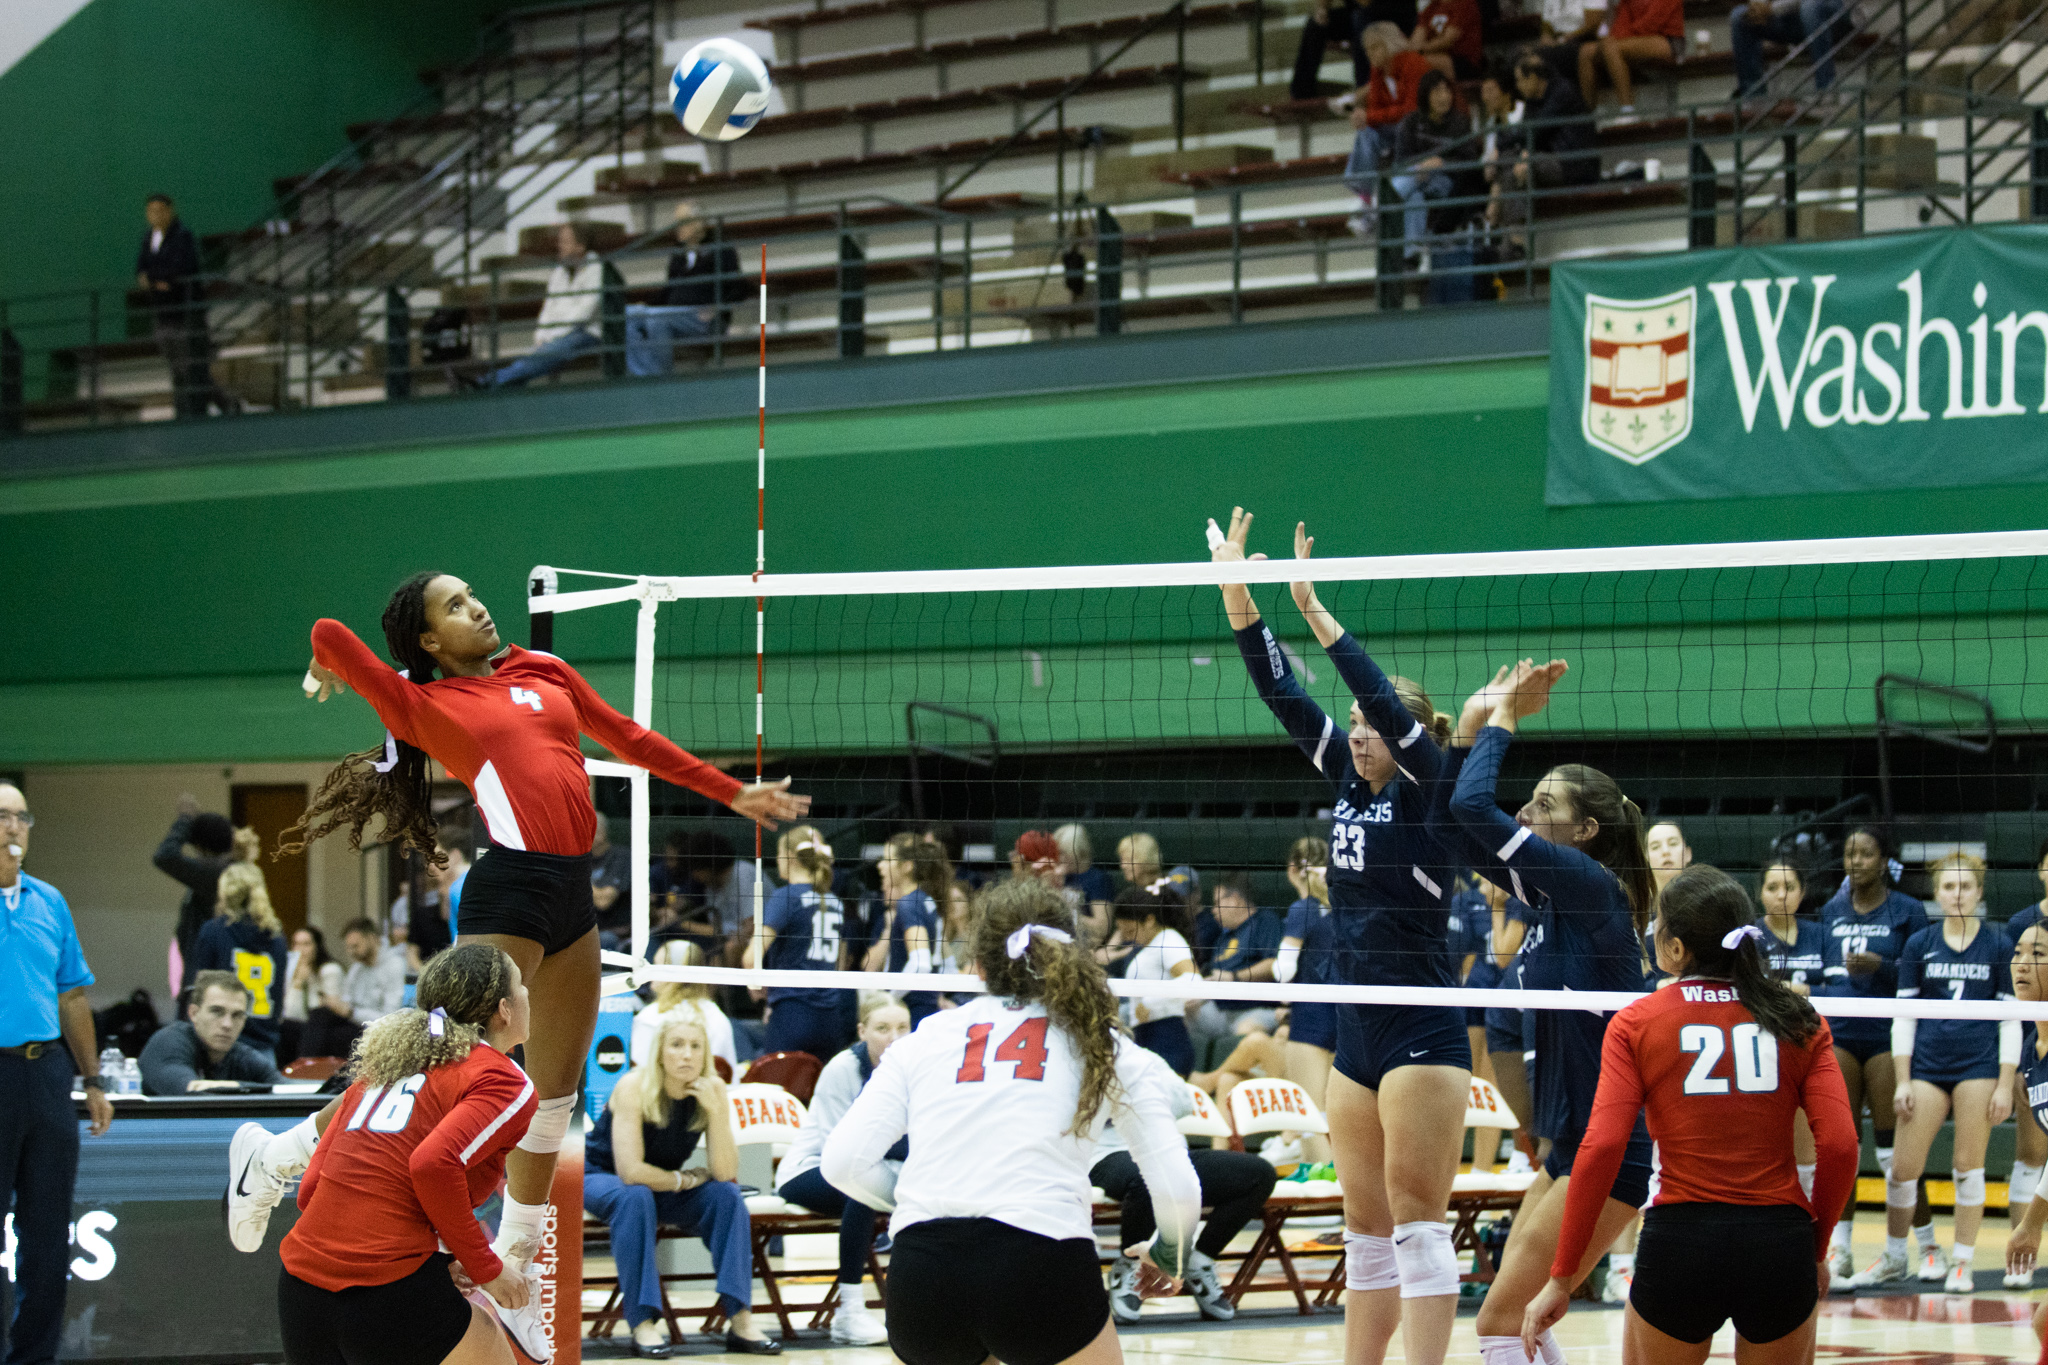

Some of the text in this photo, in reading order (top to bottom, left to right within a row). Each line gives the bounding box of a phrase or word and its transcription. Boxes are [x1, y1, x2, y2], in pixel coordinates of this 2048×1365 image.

[509, 686, 544, 711] 4
[1332, 822, 1366, 872] 23
[807, 911, 844, 963] 15
[1925, 962, 1991, 981] BRANDEIS
[1948, 980, 1966, 1000] 7
[956, 1016, 1050, 1084] 14
[1679, 1022, 1780, 1096] 20
[345, 1073, 427, 1134] 16
[733, 1098, 801, 1129] BEARS
[1244, 1088, 1307, 1118] BEARS
[542, 1204, 559, 1276] sports
